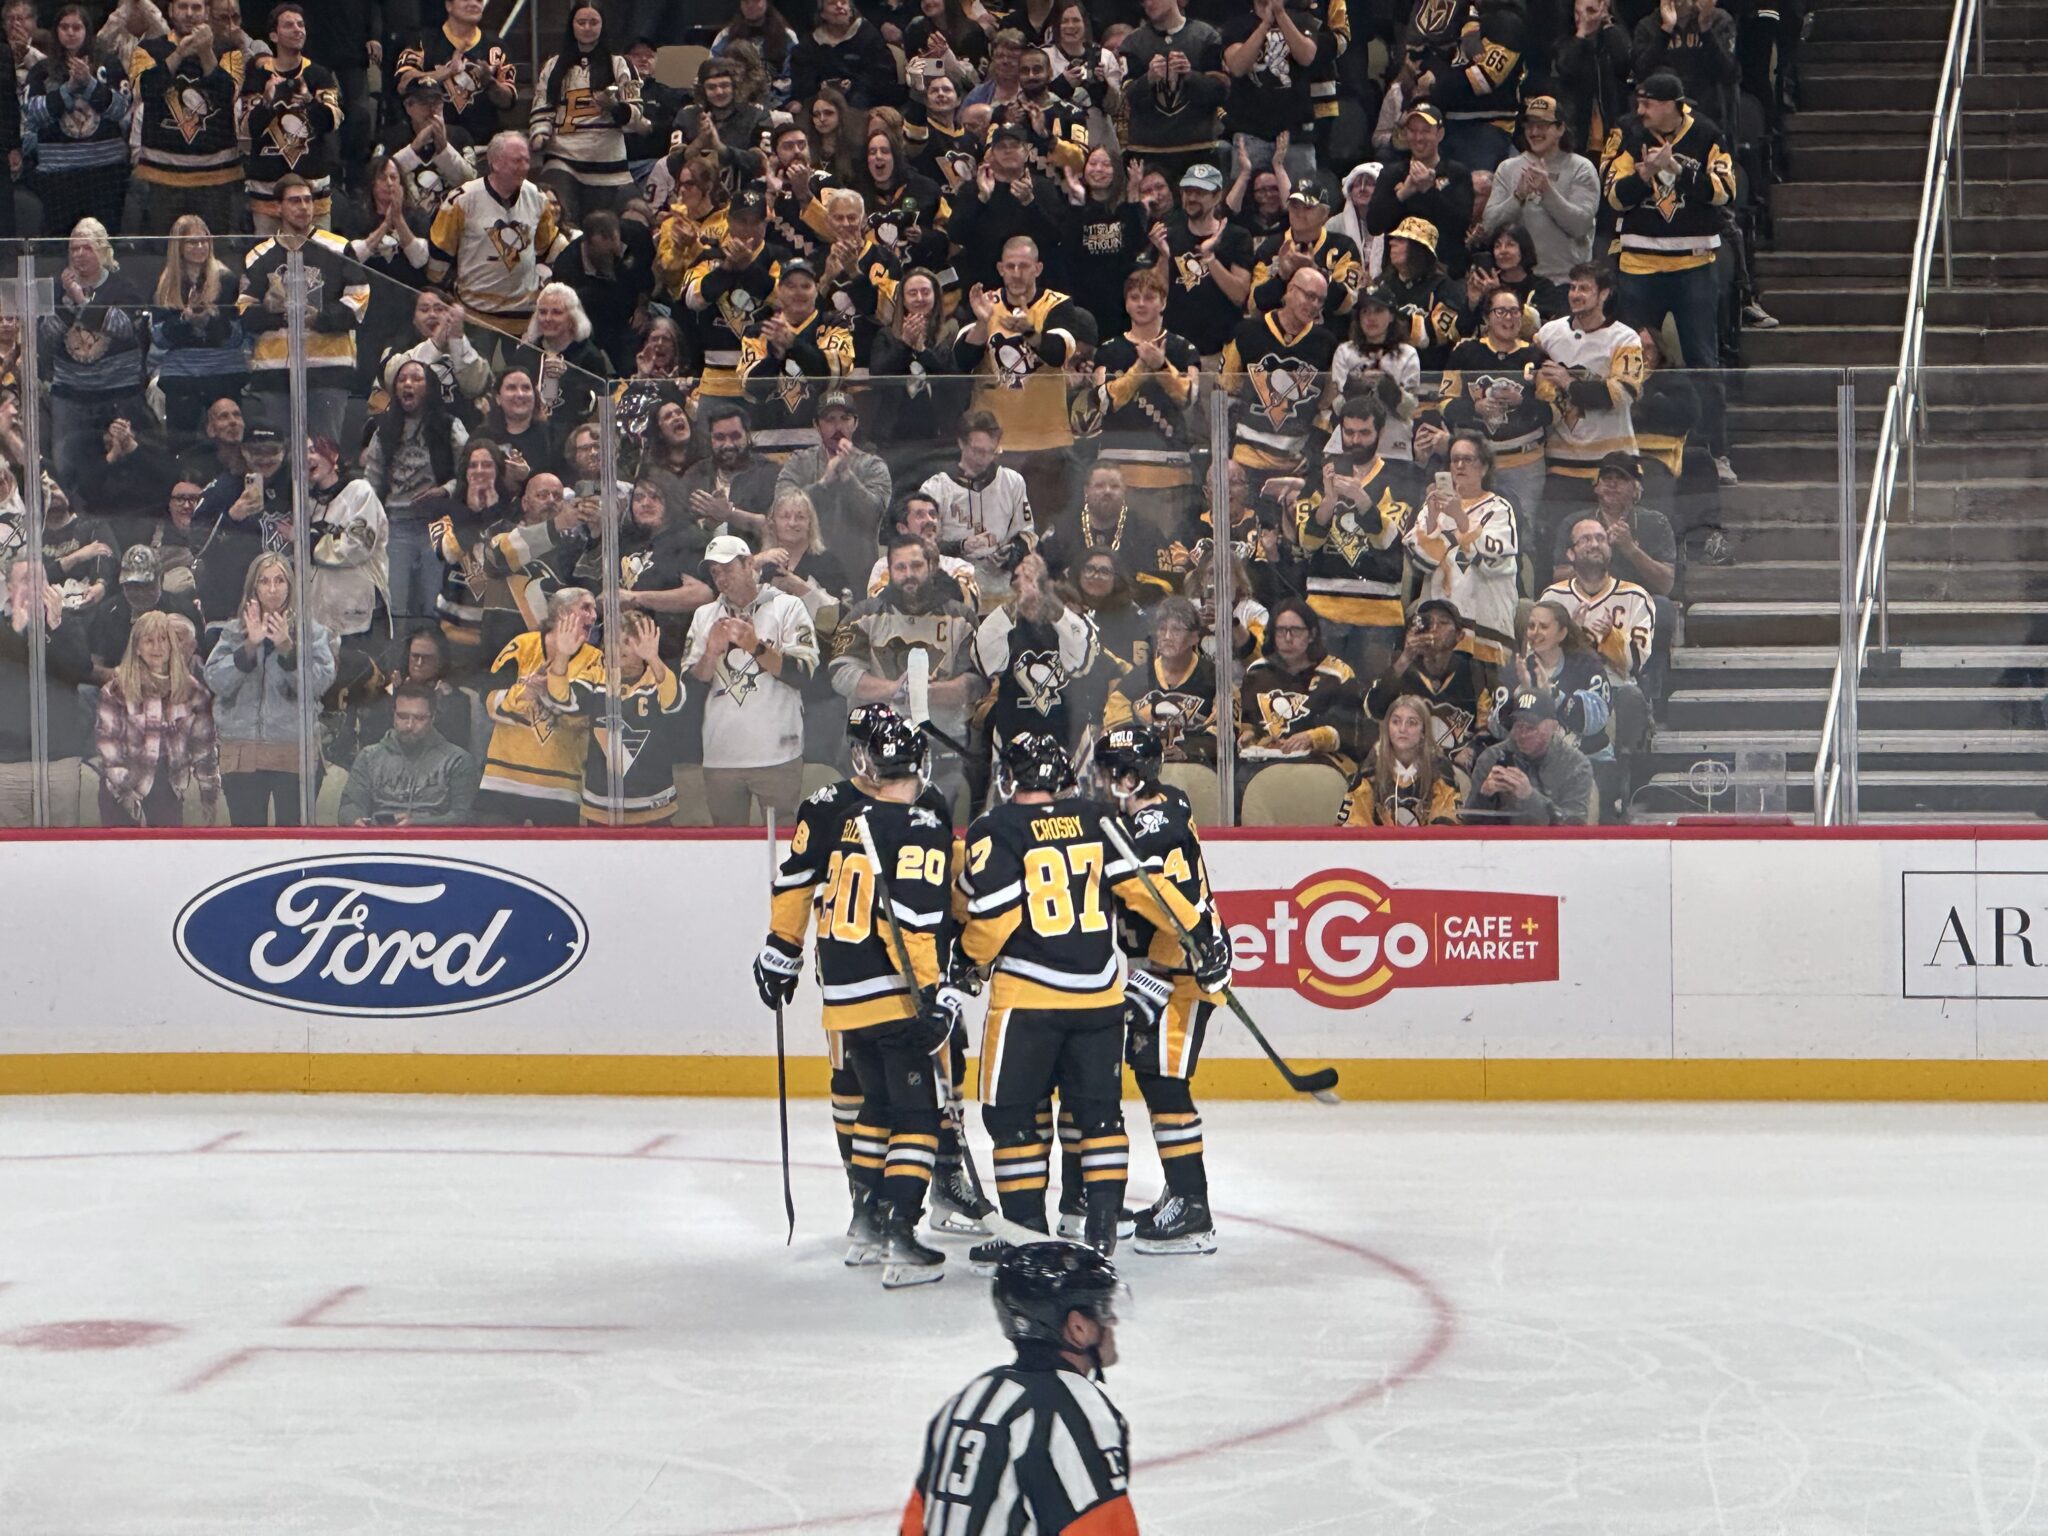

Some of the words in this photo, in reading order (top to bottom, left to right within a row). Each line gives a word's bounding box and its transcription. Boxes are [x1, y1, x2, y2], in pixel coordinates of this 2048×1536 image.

[1612, 605, 1626, 629] C
[937, 622, 947, 642] C
[637, 696, 649, 717] C
[882, 743, 896, 758] 20
[1336, 800, 1353, 821] 5
[1030, 815, 1085, 842] CROSBY
[896, 845, 946, 887] 20
[1163, 847, 1192, 883] 4
[815, 849, 876, 945] 20
[1023, 842, 1108, 938] 87
[250, 877, 513, 987] Ford
[1232, 899, 1429, 978] etGo
[1443, 916, 1513, 939] CAFE
[1923, 905, 2048, 968] AR
[1445, 940, 1539, 960] MARKET
